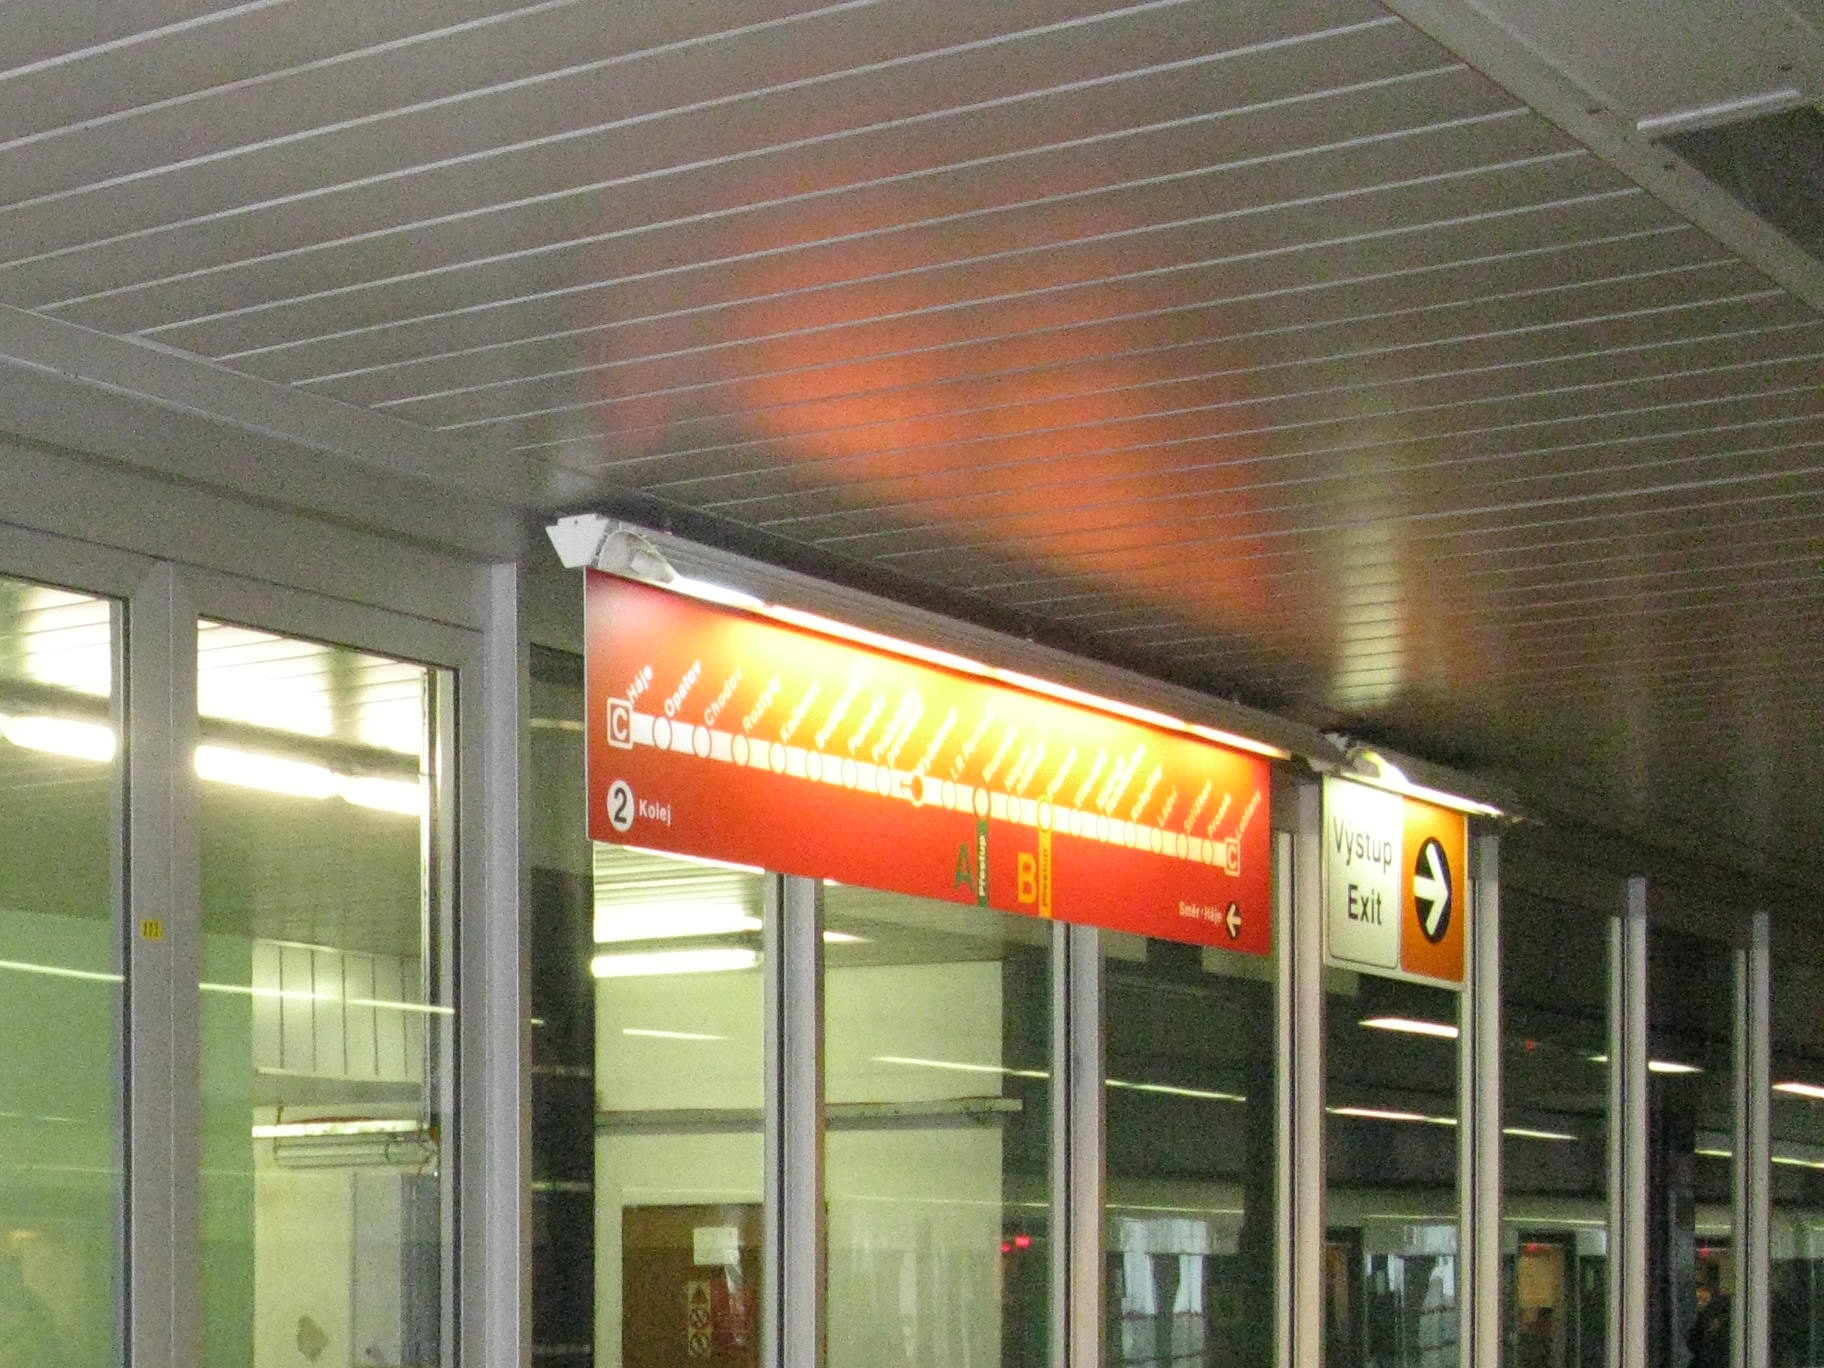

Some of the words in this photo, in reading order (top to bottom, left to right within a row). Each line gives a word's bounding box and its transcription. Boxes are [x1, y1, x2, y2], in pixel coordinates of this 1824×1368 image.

[626, 664, 653, 707] Háje
[663, 659, 701, 718] Opatov
[639, 799, 671, 828] Kolej
[954, 843, 976, 895] A
[1018, 851, 1036, 904] B
[1348, 883, 1382, 926] Exit
